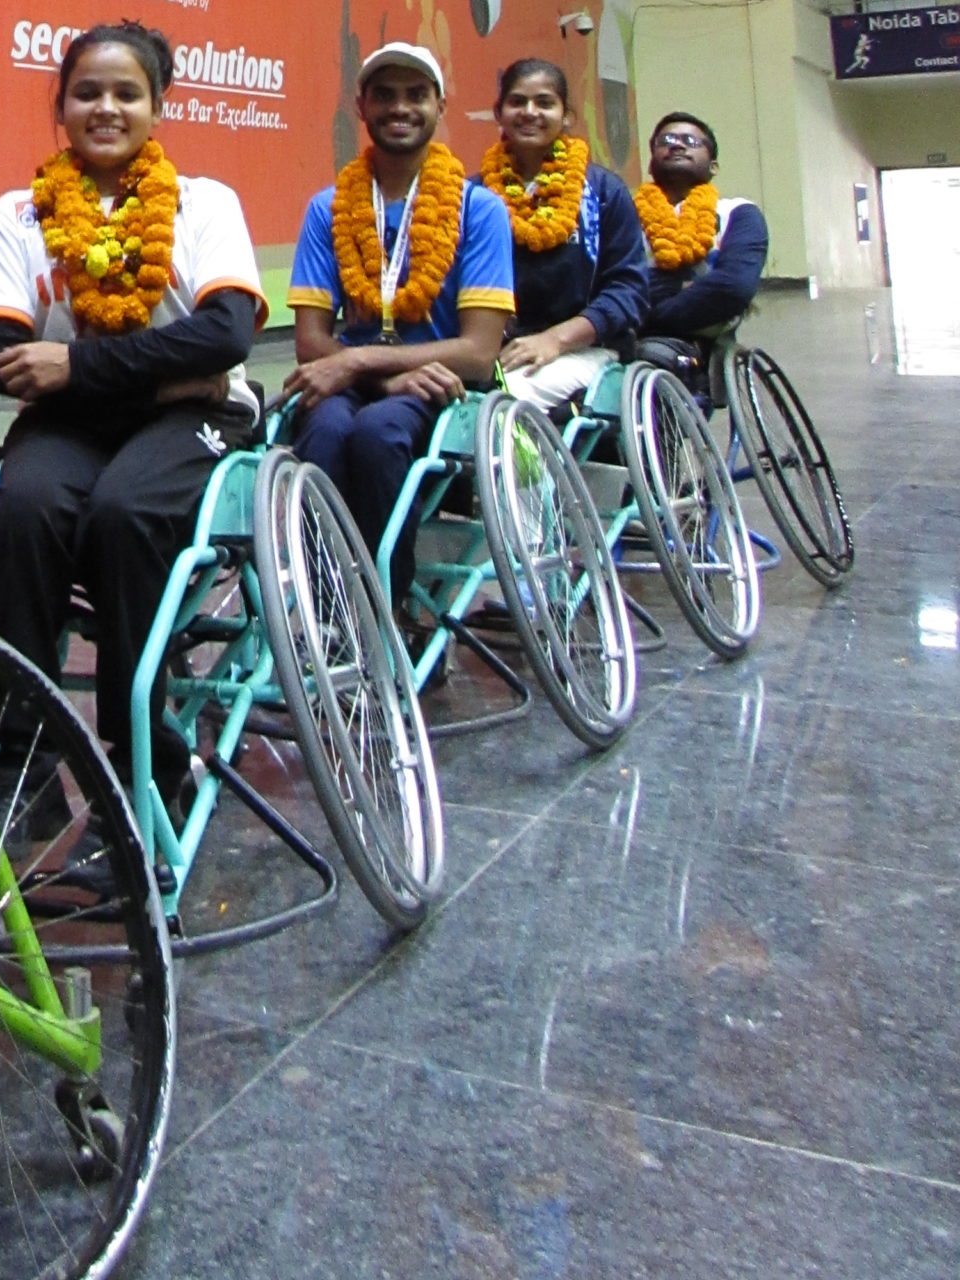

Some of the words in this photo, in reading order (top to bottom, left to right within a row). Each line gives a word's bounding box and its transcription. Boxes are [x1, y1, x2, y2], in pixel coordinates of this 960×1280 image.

[868, 13, 922, 31] Noida
[173, 41, 284, 91] solutions
[914, 55, 959, 67] Contact
[161, 100, 184, 121] nce
[187, 97, 212, 123] Par
